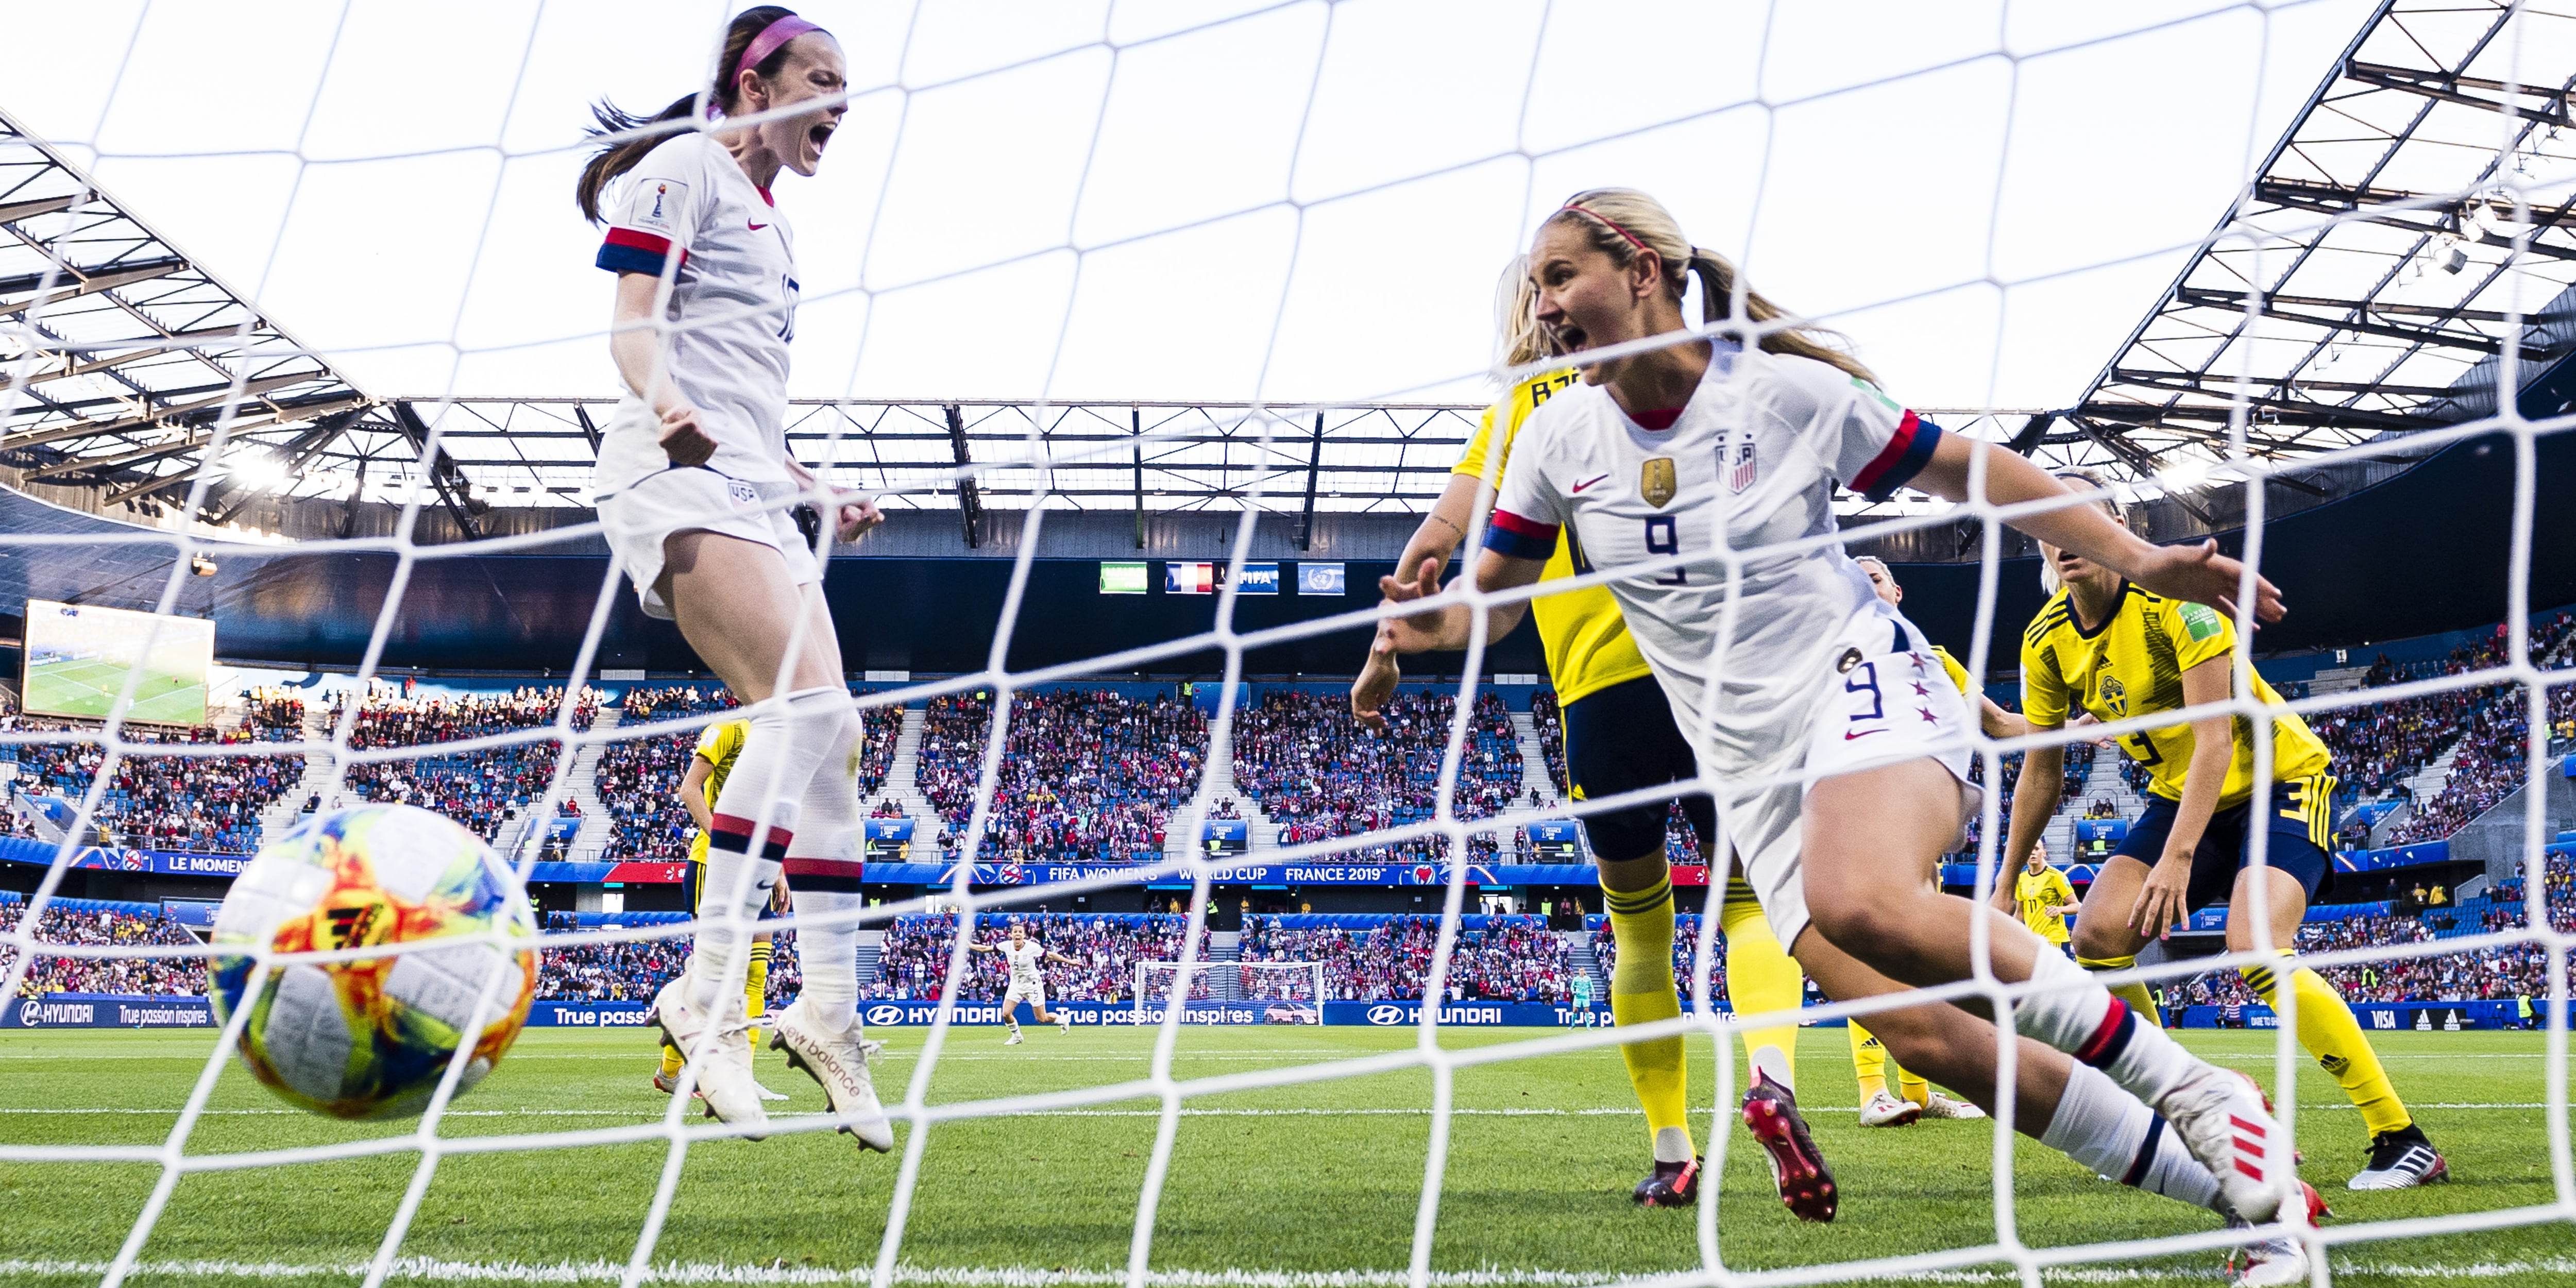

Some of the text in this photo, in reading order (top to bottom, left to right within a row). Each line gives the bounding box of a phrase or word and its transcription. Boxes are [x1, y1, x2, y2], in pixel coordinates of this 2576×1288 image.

[1645, 515, 1687, 585] 9
[1240, 571, 1271, 585] FIFA
[1845, 662, 1884, 722] 9
[2279, 776, 2313, 823] 3
[169, 857, 251, 873] LE MOMEN
[1049, 868, 1080, 880] FIFA
[1083, 868, 1158, 882] WOMEN'S
[1236, 868, 1267, 880] CUP
[1285, 868, 1345, 881] FRANCE
[2028, 899, 2037, 913] 11
[1014, 961, 1019, 970] 5
[1033, 990, 1039, 999] 5
[44, 1004, 94, 1023] HYUNDAI
[120, 1005, 207, 1027] True passion inspires
[554, 1007, 652, 1027] True passi
[908, 1007, 1002, 1023] HYUNDAI
[1057, 1007, 1098, 1023] True
[1181, 1006, 1253, 1026] inspires
[2371, 1010, 2396, 1029] VISA
[807, 1040, 860, 1096] balance
